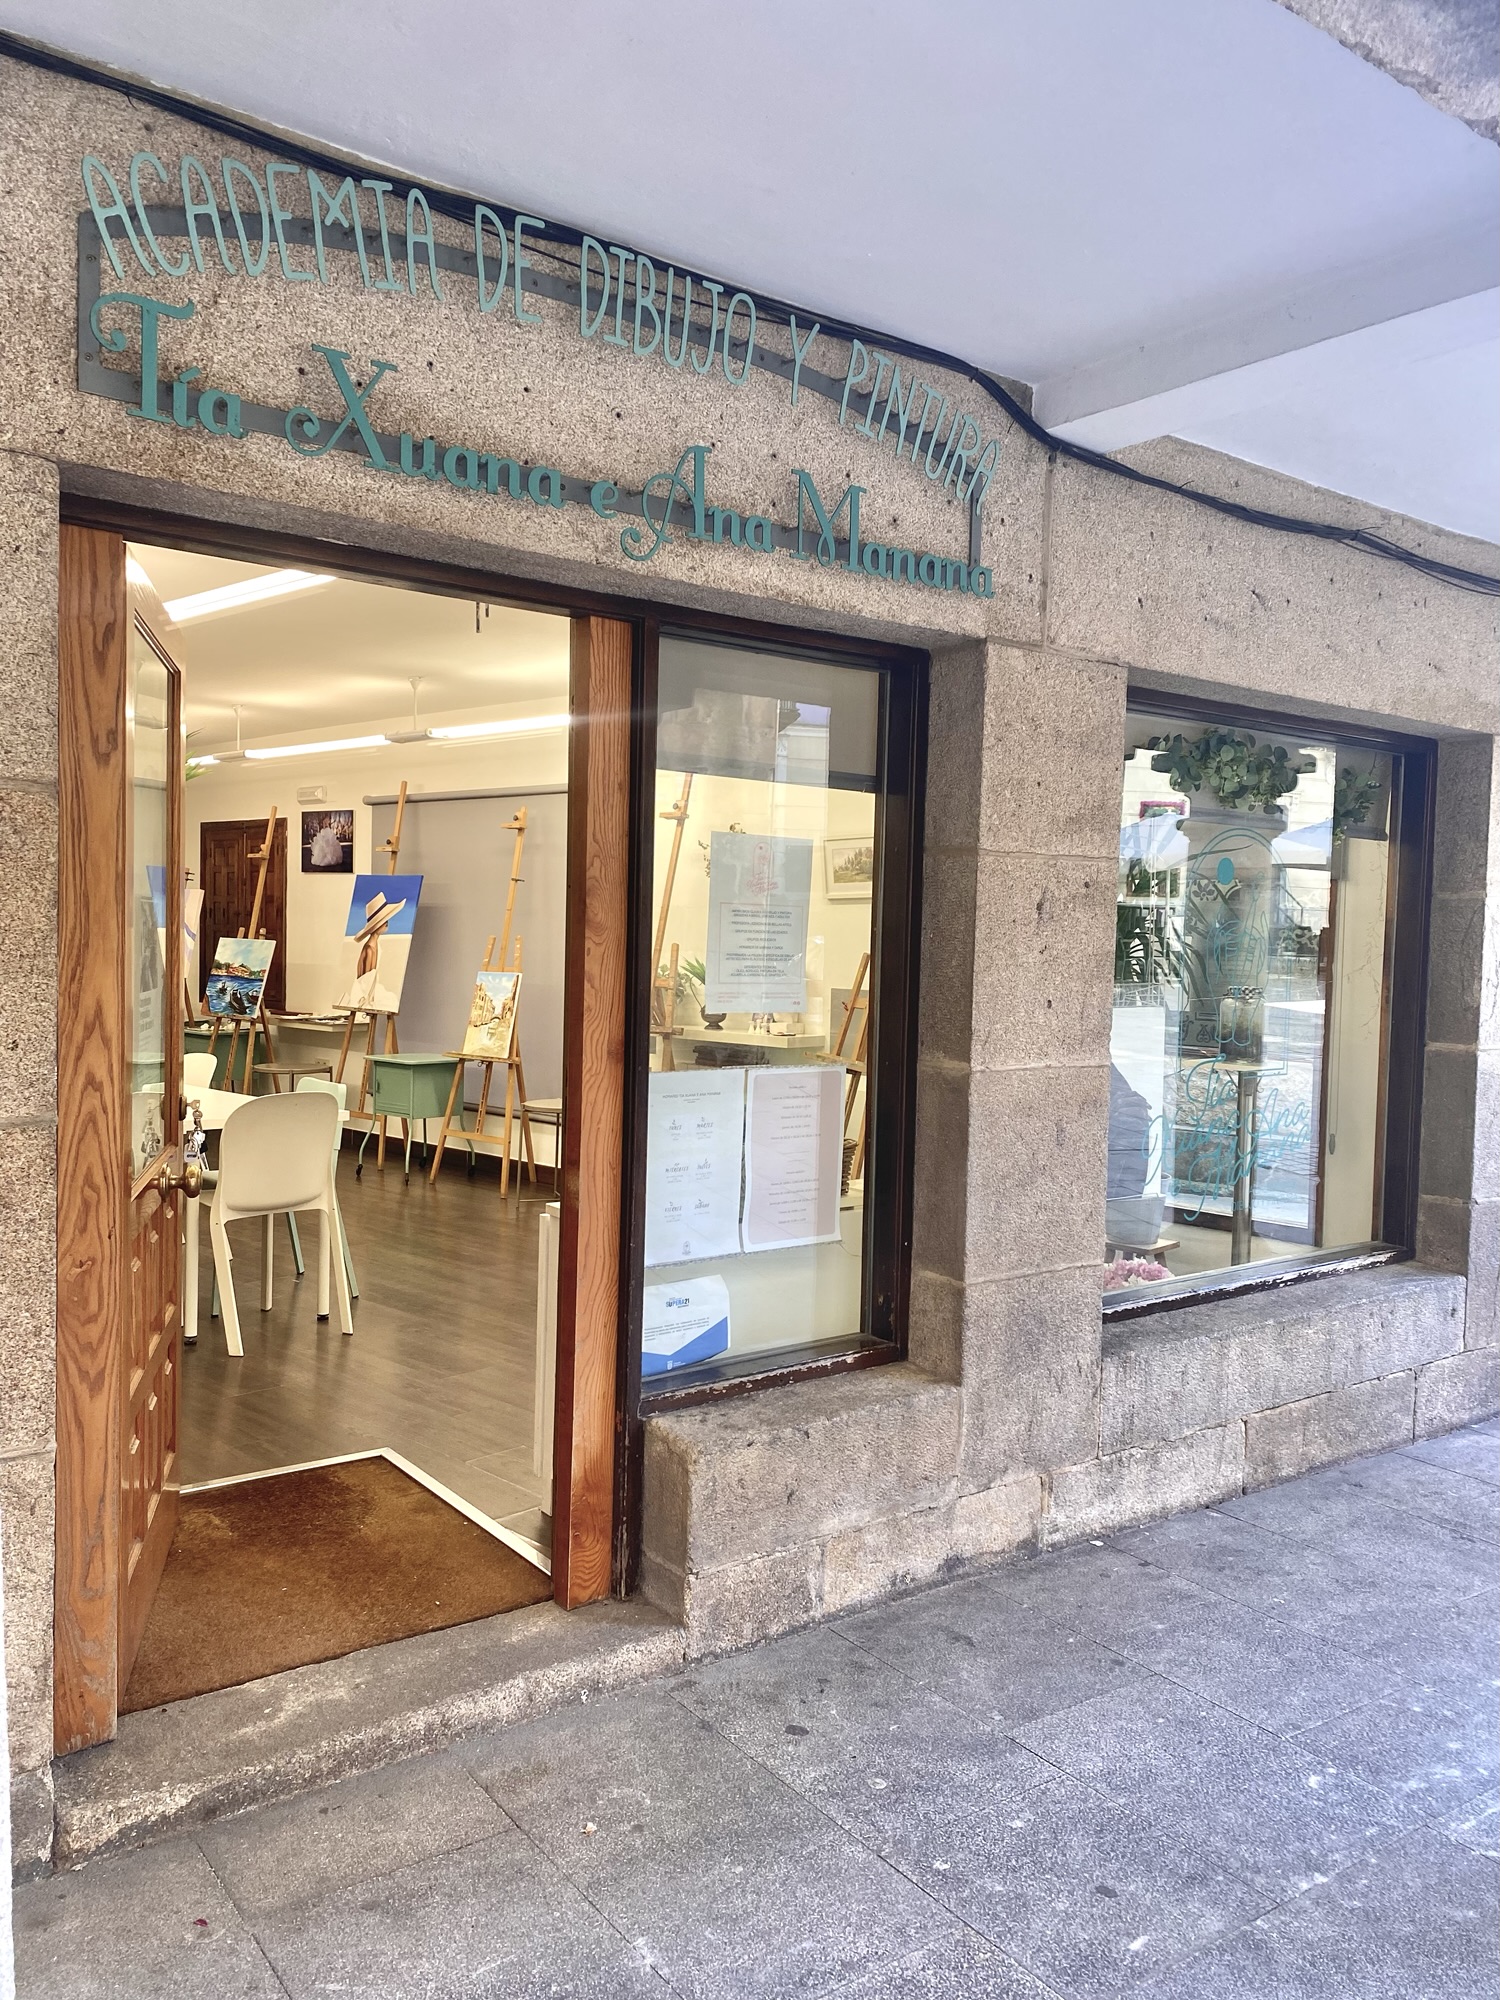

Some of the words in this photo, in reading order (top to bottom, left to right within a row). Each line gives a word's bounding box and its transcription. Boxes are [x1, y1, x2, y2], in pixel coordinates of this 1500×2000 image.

[81, 151, 441, 300] ACADEMIA
[475, 203, 545, 324] DE
[580, 235, 757, 386] DIBUJO
[789, 314, 820, 406] Y
[839, 338, 999, 516] PINTURA
[89, 291, 248, 439] Tía
[284, 343, 566, 510] Xuana
[589, 479, 620, 519] e
[620, 444, 777, 562] Ana
[789, 468, 995, 599] Manana
